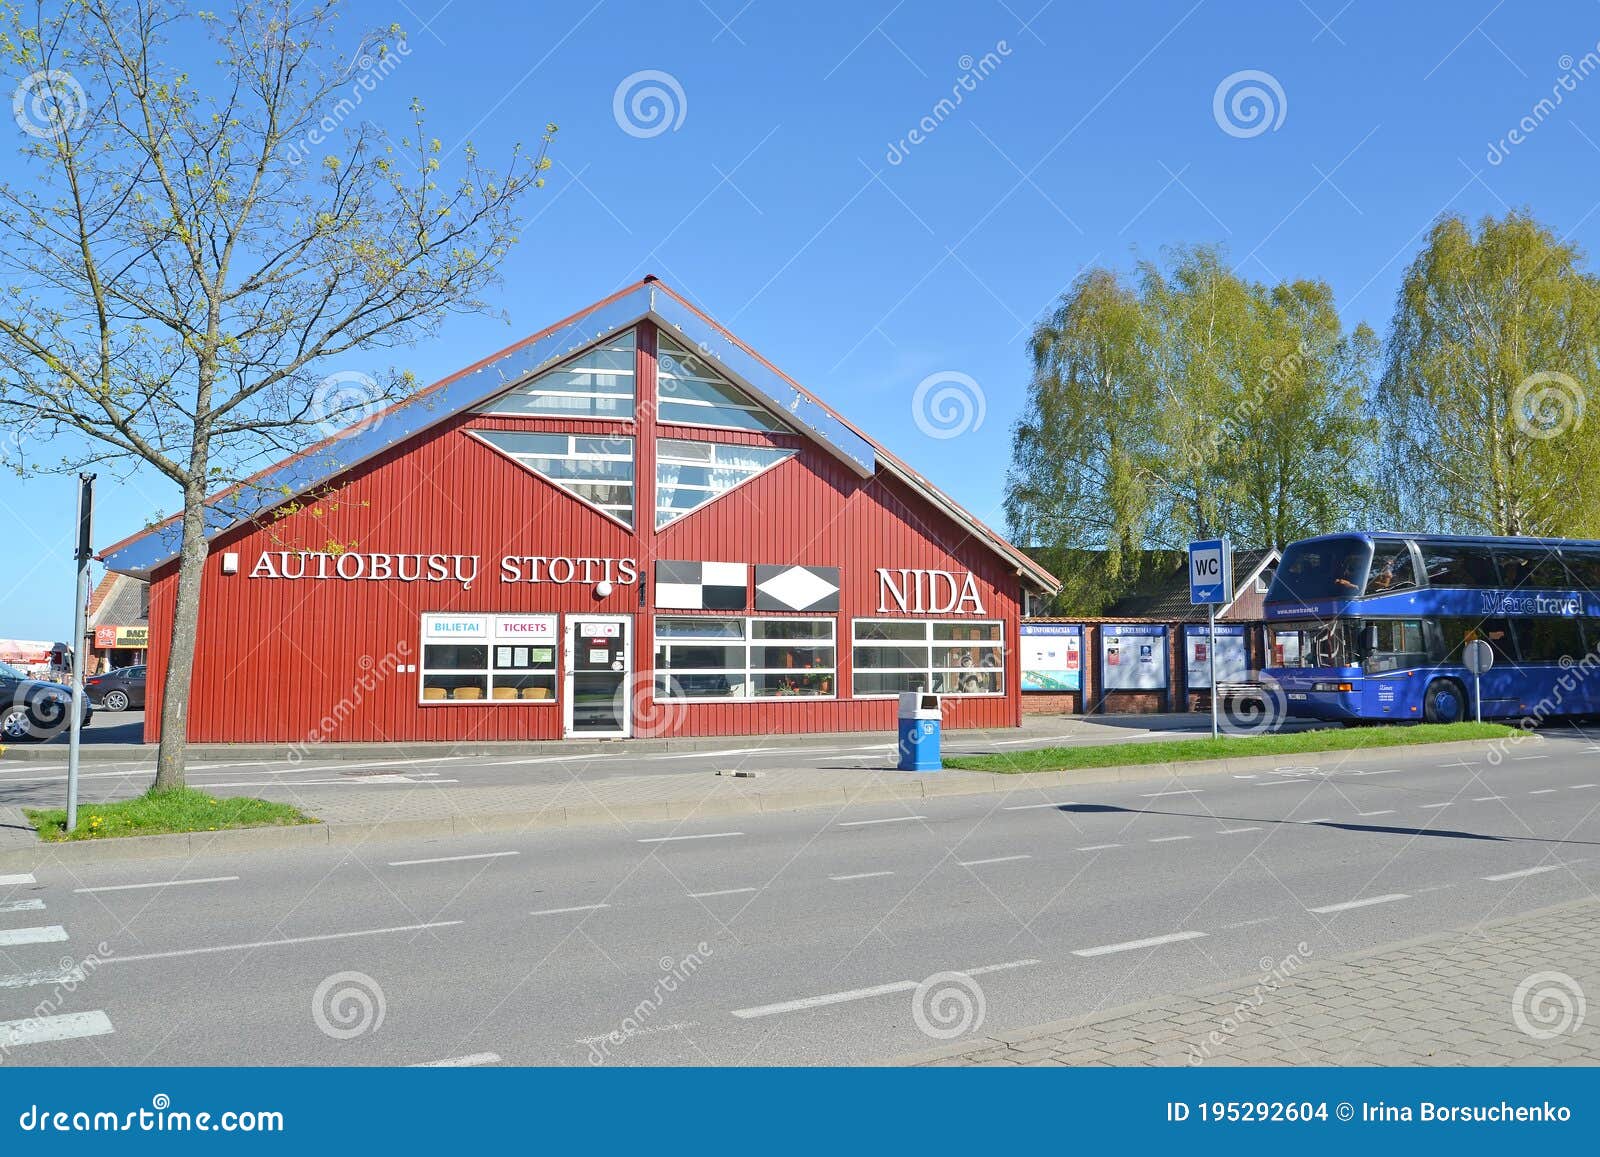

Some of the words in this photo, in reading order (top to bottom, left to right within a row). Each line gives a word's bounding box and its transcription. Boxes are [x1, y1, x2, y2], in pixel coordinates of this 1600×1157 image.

[248, 550, 480, 590] AUTOBUSŲ
[500, 556, 637, 584] STOTIS
[1195, 558, 1218, 576] WC
[876, 568, 987, 614] NIDA
[1481, 591, 1585, 615] Maretravel
[434, 622, 480, 632] BILIETAI
[503, 623, 547, 632] TICKETS
